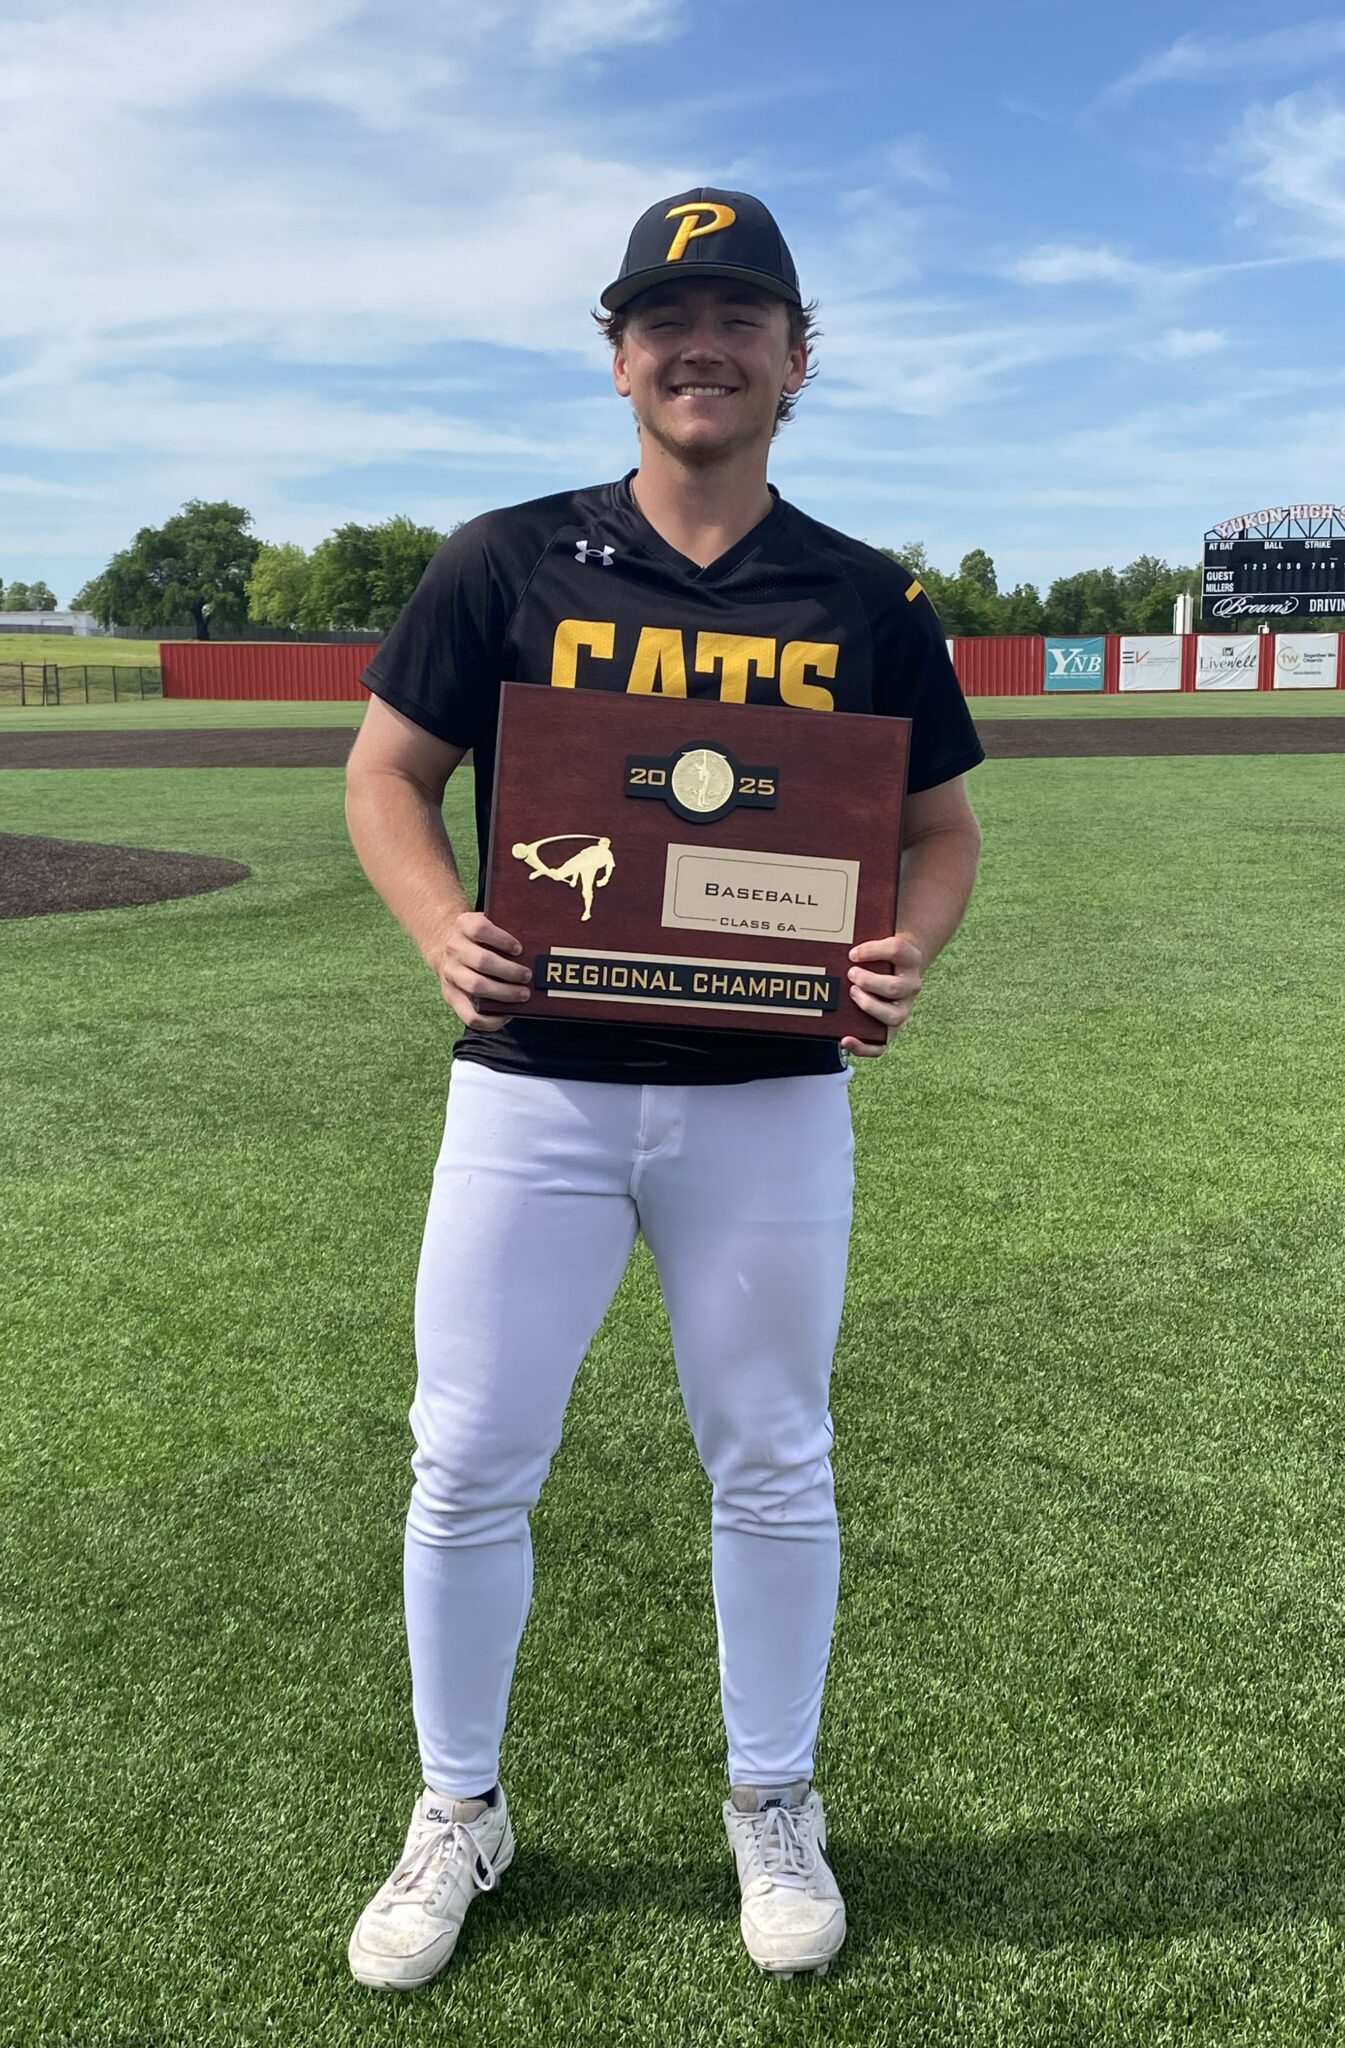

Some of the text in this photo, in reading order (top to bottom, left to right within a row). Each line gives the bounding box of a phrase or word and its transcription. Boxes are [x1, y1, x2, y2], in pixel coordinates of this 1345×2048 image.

[664, 202, 737, 262] P
[1213, 506, 1284, 539] YUKON
[1288, 503, 1335, 520] HIGH
[1208, 542, 1234, 551] AT BAT
[1264, 541, 1284, 550] BALL
[1304, 540, 1332, 549] STRIKE
[1206, 571, 1234, 581] GUEST
[1206, 582, 1234, 592] MILLERS
[1212, 596, 1299, 618] Brown's
[551, 618, 840, 712] CATS
[1048, 648, 1102, 676] YNB
[629, 767, 775, 796] 20 25
[719, 916, 797, 934] CLASS 6A
[546, 962, 831, 1002] REGIONAL CHAMPION
